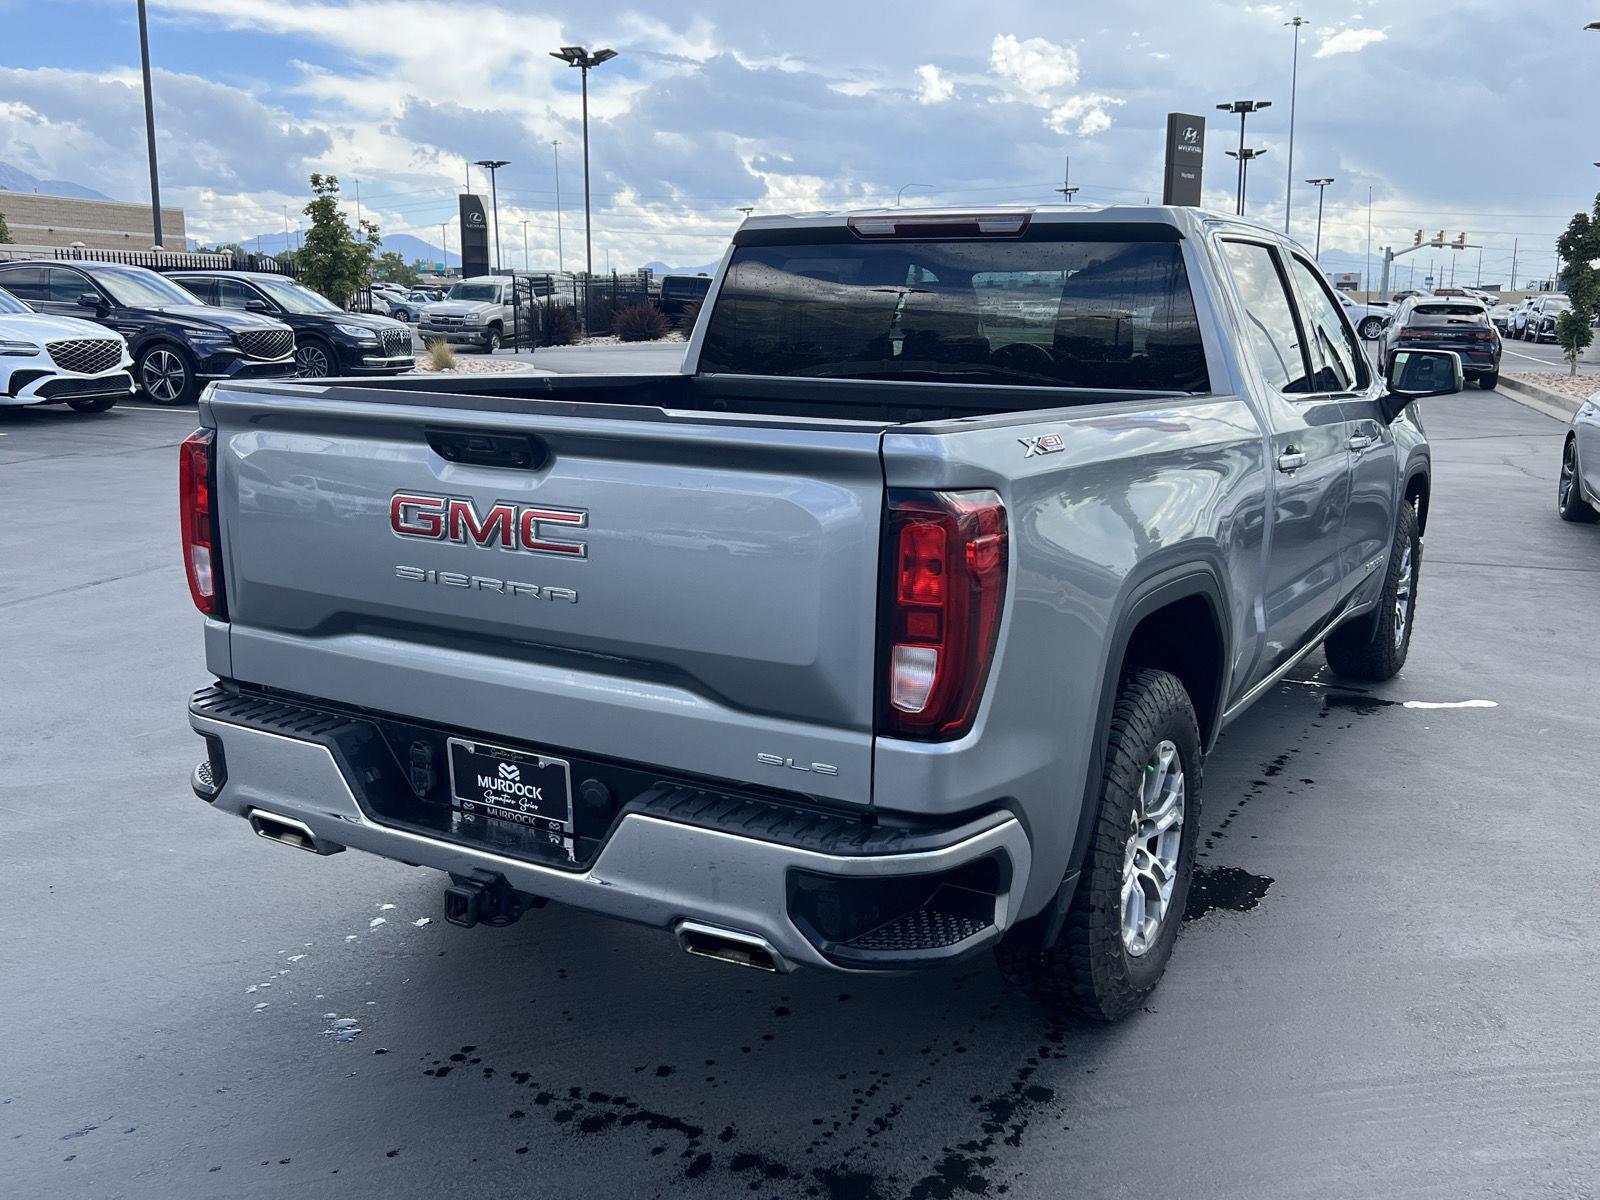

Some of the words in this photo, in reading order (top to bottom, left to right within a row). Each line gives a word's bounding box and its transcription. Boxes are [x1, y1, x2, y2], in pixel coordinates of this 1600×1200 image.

[390, 490, 589, 560] GMC
[394, 564, 579, 604] SIERRA
[477, 774, 543, 801] MURDOCK
[483, 789, 517, 805] Signature
[518, 797, 539, 812] Series
[486, 806, 537, 826] MURDOCK
